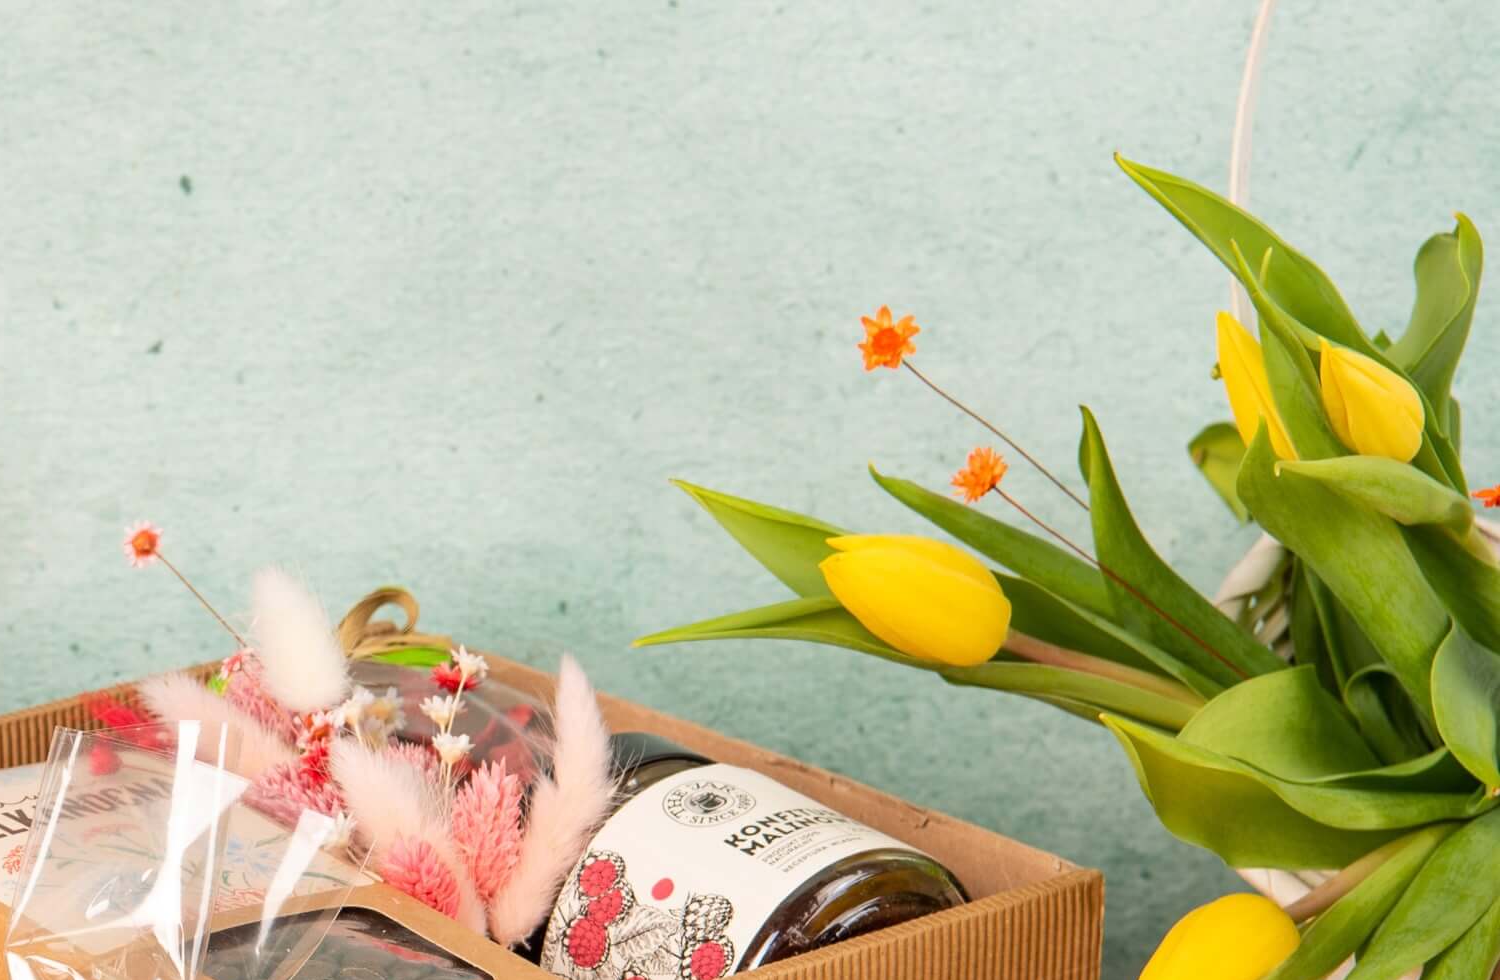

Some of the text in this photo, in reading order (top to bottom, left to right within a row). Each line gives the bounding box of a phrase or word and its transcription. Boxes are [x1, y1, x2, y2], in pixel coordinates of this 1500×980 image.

[667, 789, 689, 819] THE
[724, 808, 836, 848] KONFIT
[740, 815, 850, 857] MALINO
